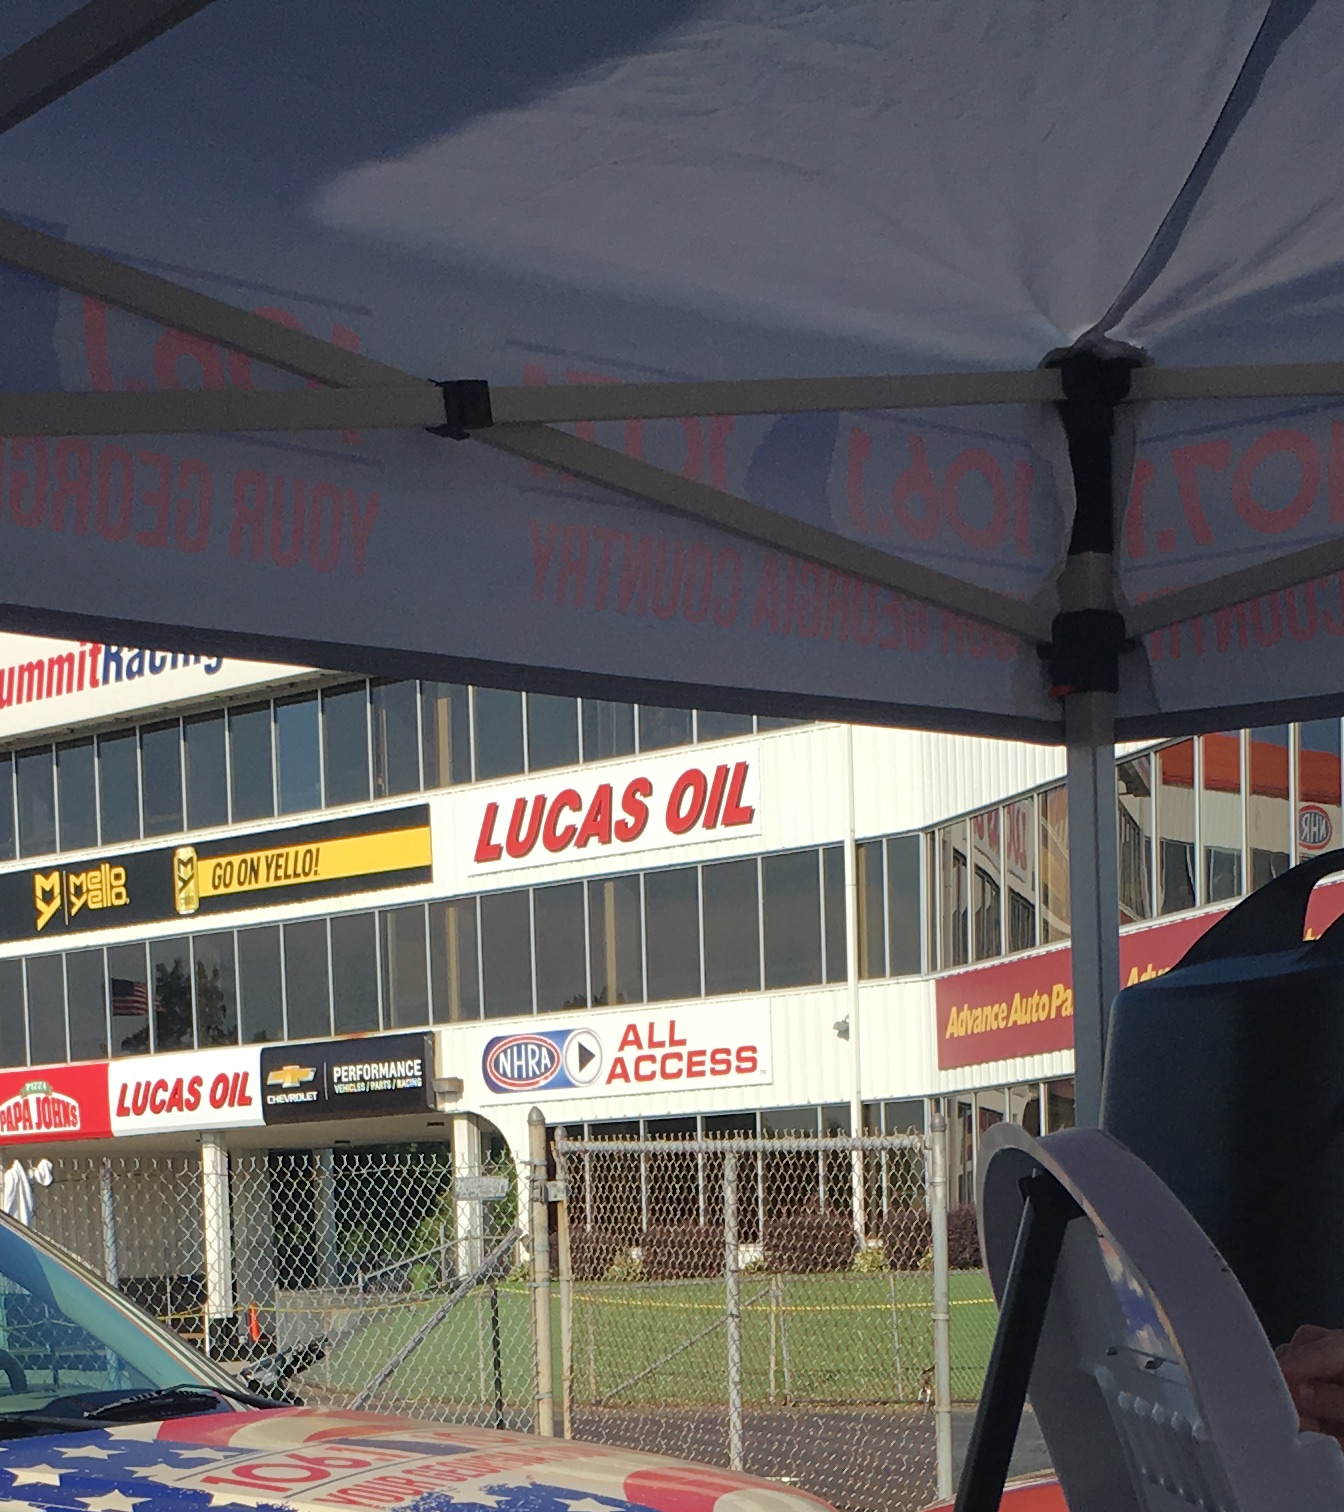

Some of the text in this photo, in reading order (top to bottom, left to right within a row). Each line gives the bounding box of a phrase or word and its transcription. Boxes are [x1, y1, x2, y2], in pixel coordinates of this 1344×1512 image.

[474, 760, 756, 864] LUCAS OIL
[212, 847, 320, 890] GO ON YELLO!
[945, 983, 1073, 1039] Advance Auto Pa
[618, 1020, 687, 1052] ALL
[333, 1060, 422, 1082] PERFORMANCE
[498, 1045, 552, 1079] NHRA
[605, 1045, 758, 1085] ACCESS
[116, 1071, 252, 1117] LUCAS OIL
[267, 1091, 318, 1104] CHEVROLET
[334, 1082, 365, 1094] VEHICLES
[371, 1079, 391, 1091] PARTS
[397, 1077, 422, 1088] RACING
[0, 1099, 33, 1132] PAPA
